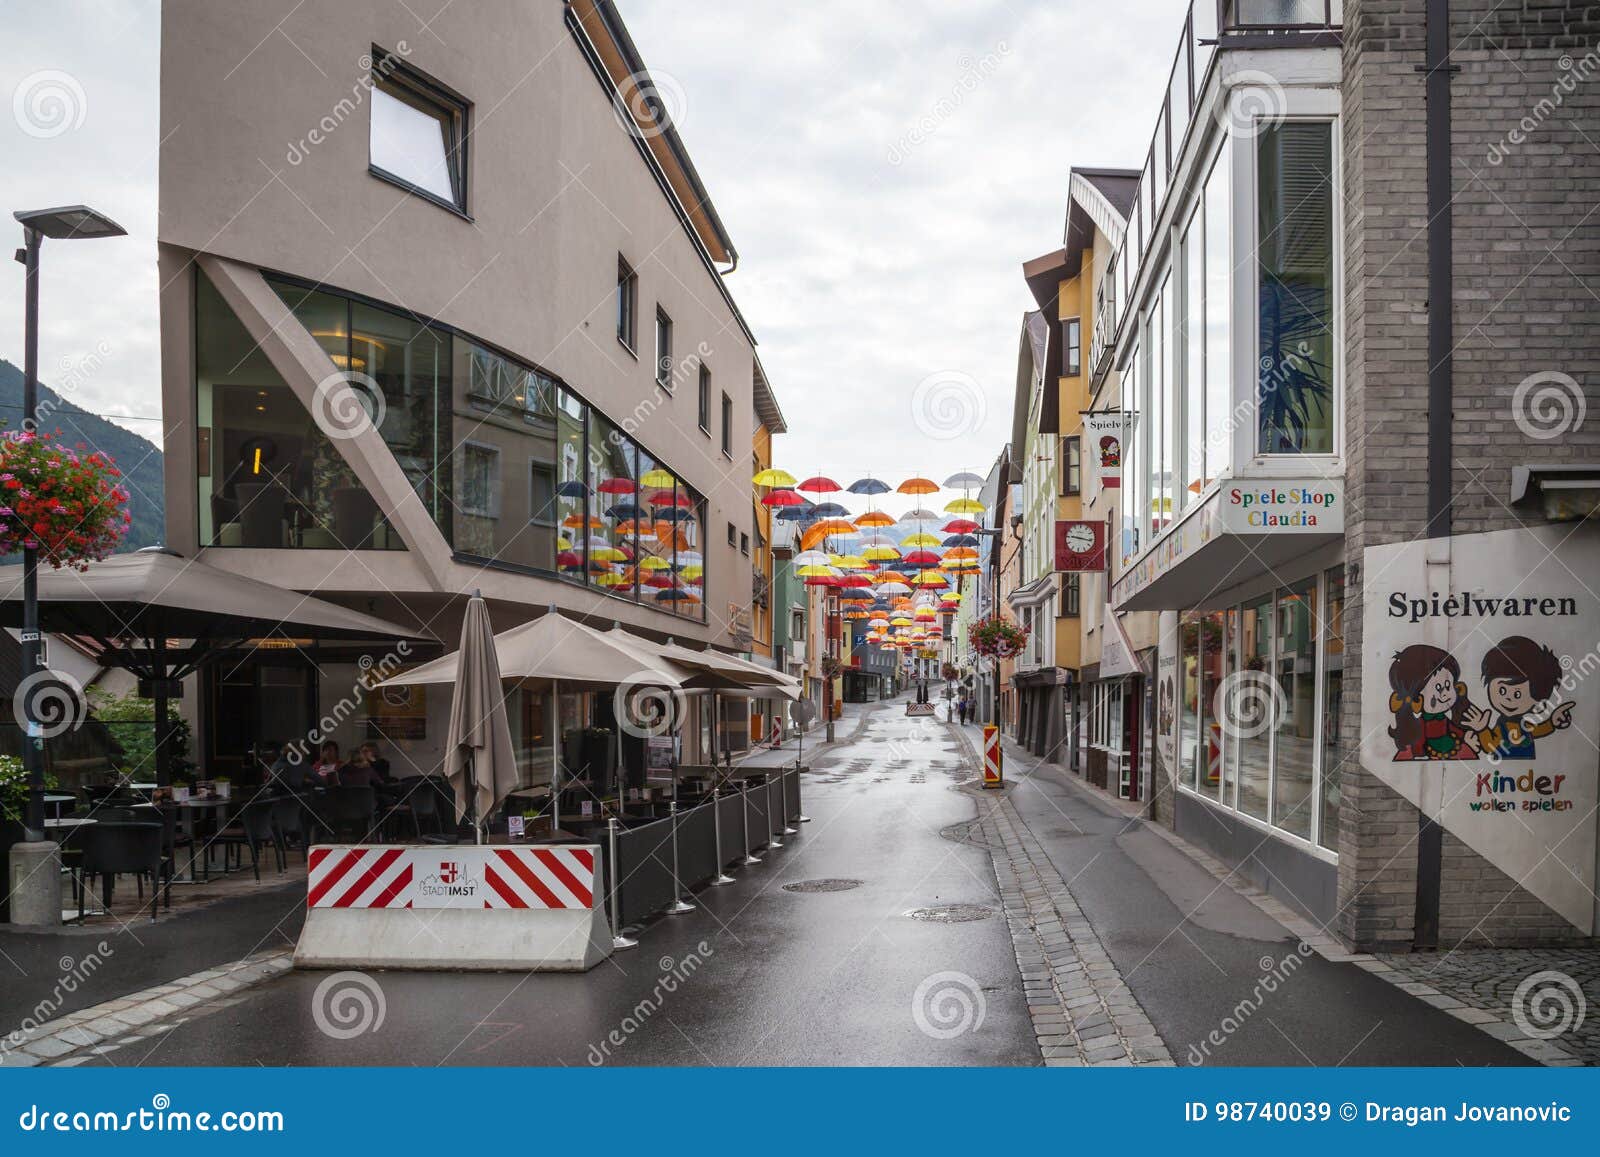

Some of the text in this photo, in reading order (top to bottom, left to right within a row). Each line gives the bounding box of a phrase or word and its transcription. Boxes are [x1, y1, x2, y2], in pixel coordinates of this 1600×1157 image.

[1231, 488, 1335, 508] Spiele Shop
[1247, 511, 1317, 526] Claudia
[1388, 592, 1578, 623] Spielwaren
[1476, 769, 1566, 797] Kinder
[1470, 798, 1573, 812] wollen spielen
